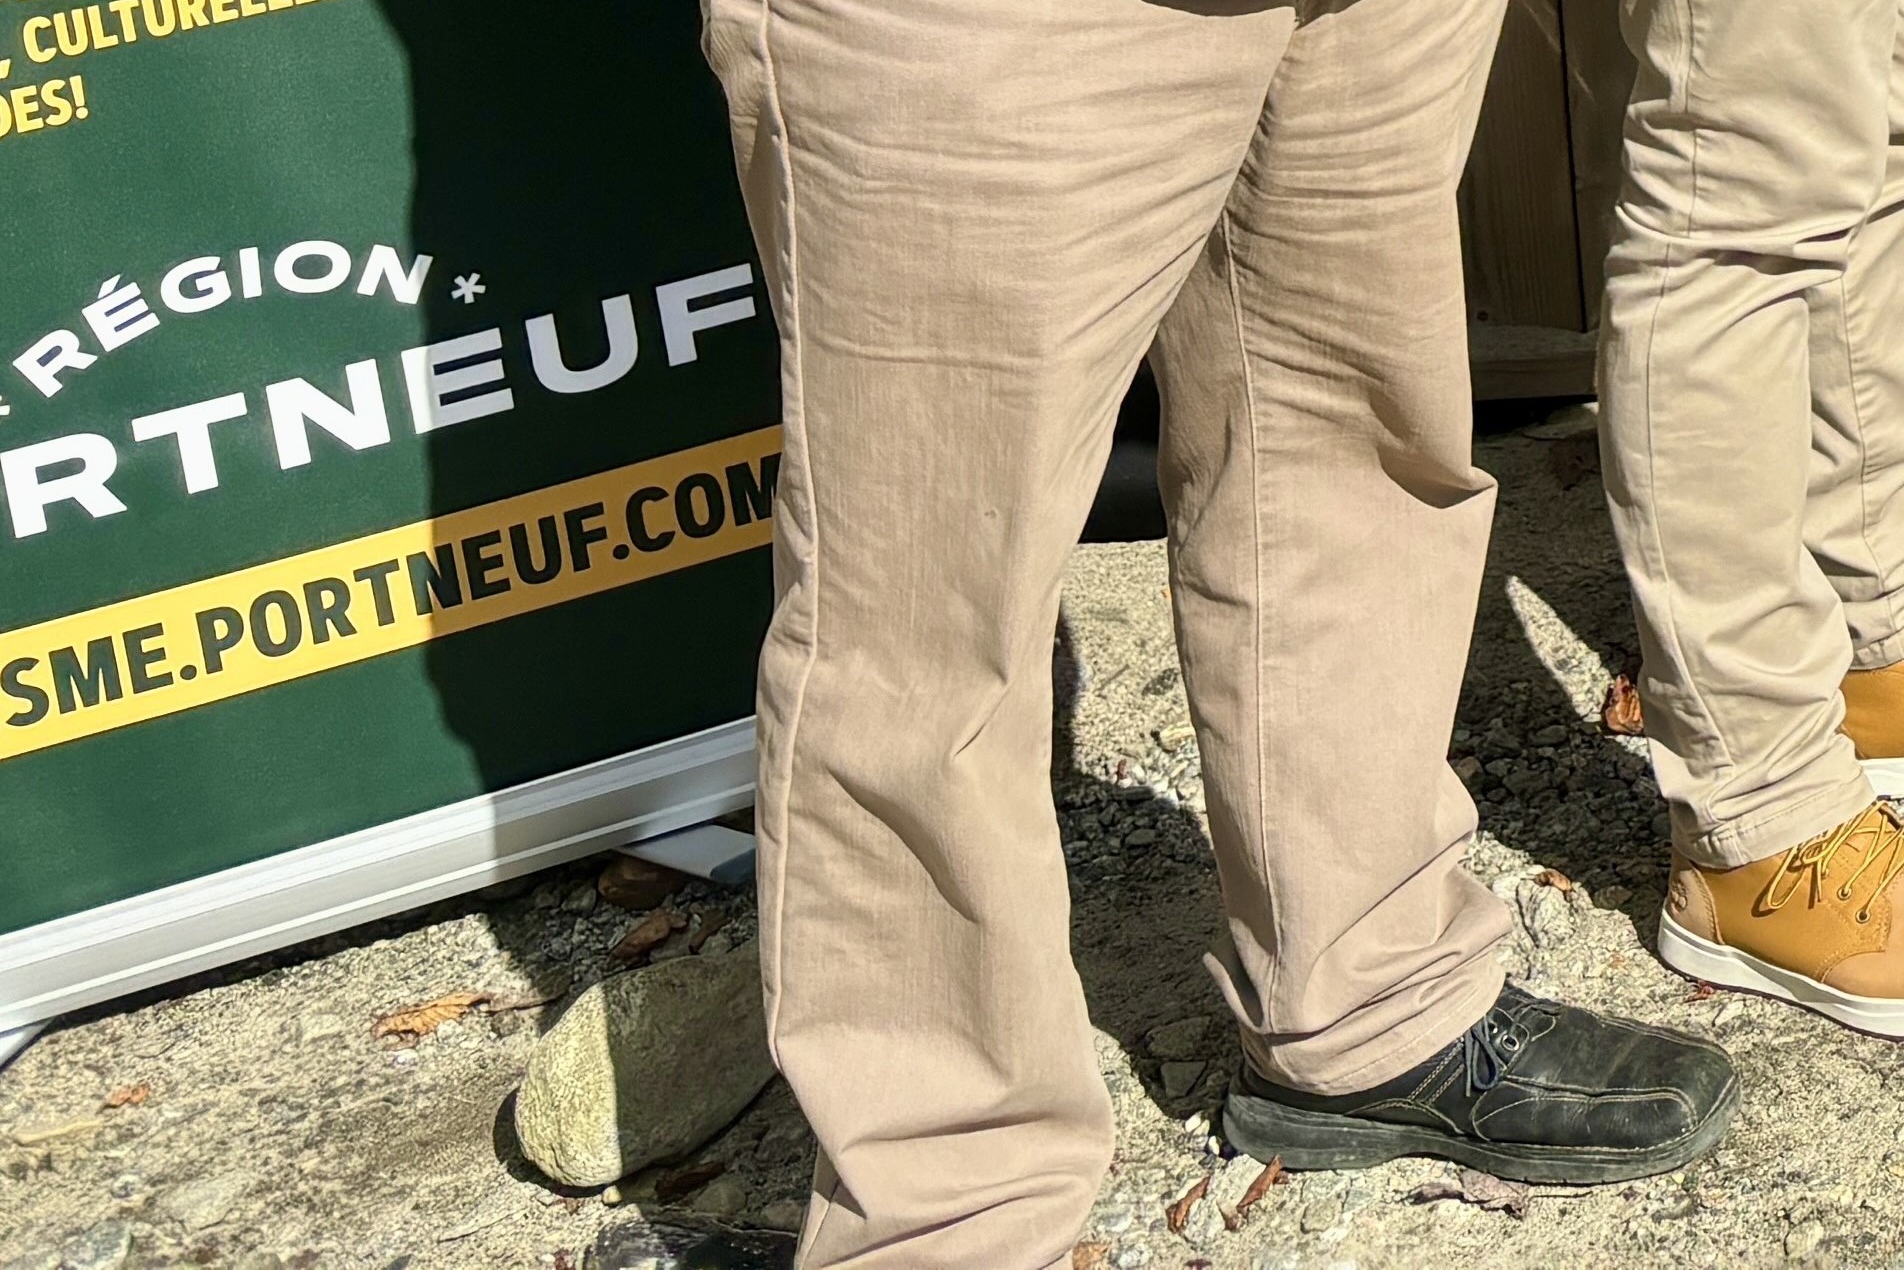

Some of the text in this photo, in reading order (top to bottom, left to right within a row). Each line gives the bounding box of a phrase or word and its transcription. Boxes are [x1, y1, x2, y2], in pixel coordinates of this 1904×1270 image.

[0, 262, 756, 539] RTNEUF
[12, 241, 432, 398] RÉGION
[0, 451, 782, 727] SME.PORTNEUF.COM
